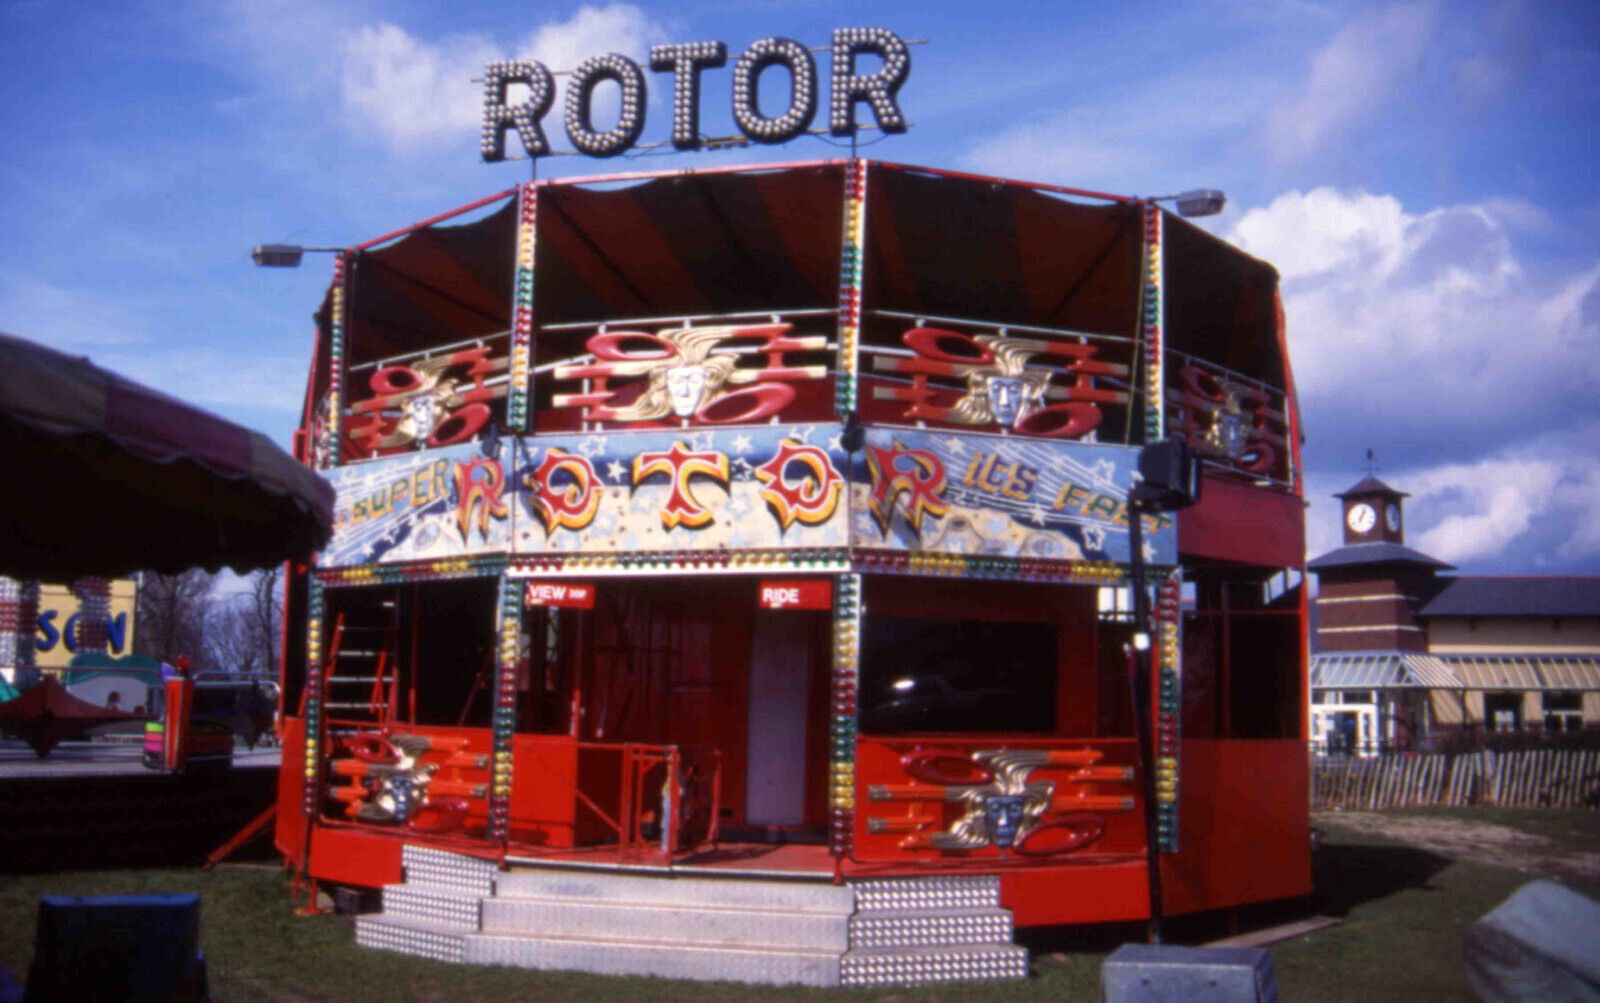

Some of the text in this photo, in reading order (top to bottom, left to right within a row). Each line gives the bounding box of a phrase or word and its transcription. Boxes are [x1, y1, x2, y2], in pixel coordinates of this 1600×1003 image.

[481, 28, 911, 161] ROTOR
[351, 458, 449, 526] SUPER
[453, 438, 950, 543] ROTOR
[529, 585, 567, 600] VIEW
[763, 588, 800, 603] RIDE
